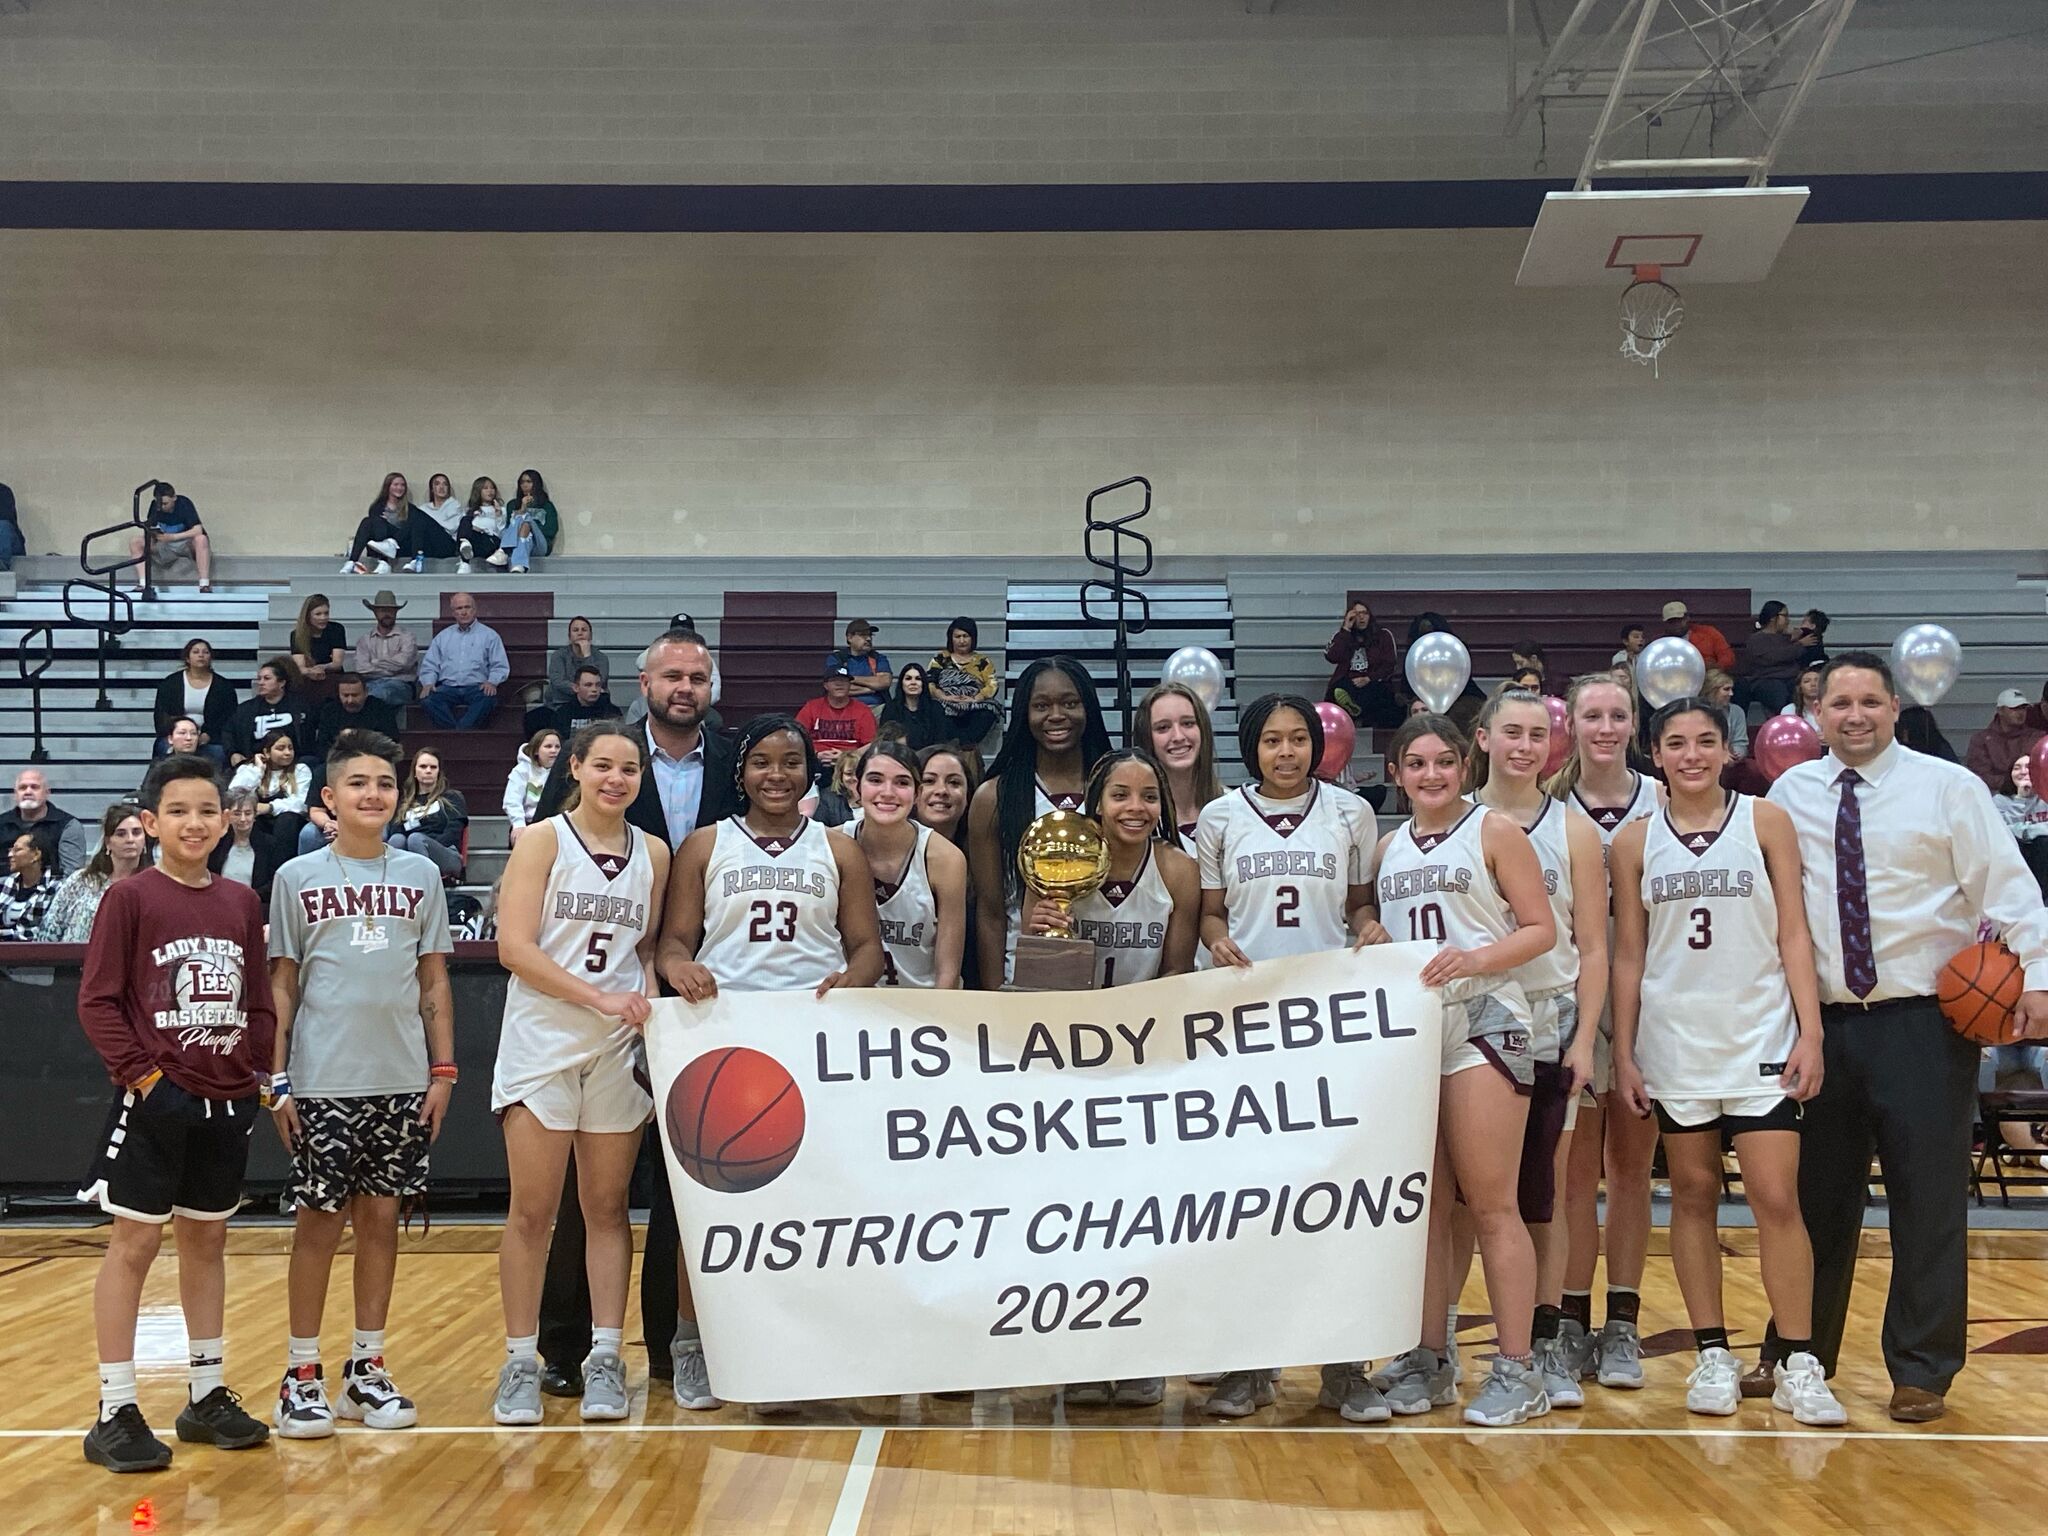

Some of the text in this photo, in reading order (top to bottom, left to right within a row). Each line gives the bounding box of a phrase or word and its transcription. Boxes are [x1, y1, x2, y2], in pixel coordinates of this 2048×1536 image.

[723, 866, 825, 898] REBELS
[1237, 850, 1336, 883] REBELS
[1380, 864, 1472, 903] REBELS
[1651, 869, 1754, 904] REBELS
[298, 883, 424, 926] FAMILY
[555, 891, 644, 931] REBELS
[749, 900, 797, 942] 23
[1276, 886, 1300, 927] 2
[1408, 902, 1447, 942] 10
[1688, 908, 1712, 950] 3
[152, 937, 199, 967] LADY
[585, 932, 613, 973] 5
[817, 987, 1417, 1083] LHS LADY REBEL
[886, 1076, 1359, 1161] BASKETBALL
[700, 1171, 1428, 1274] DISTRICT CHAMPIONS
[989, 1276, 1150, 1337] 2022
